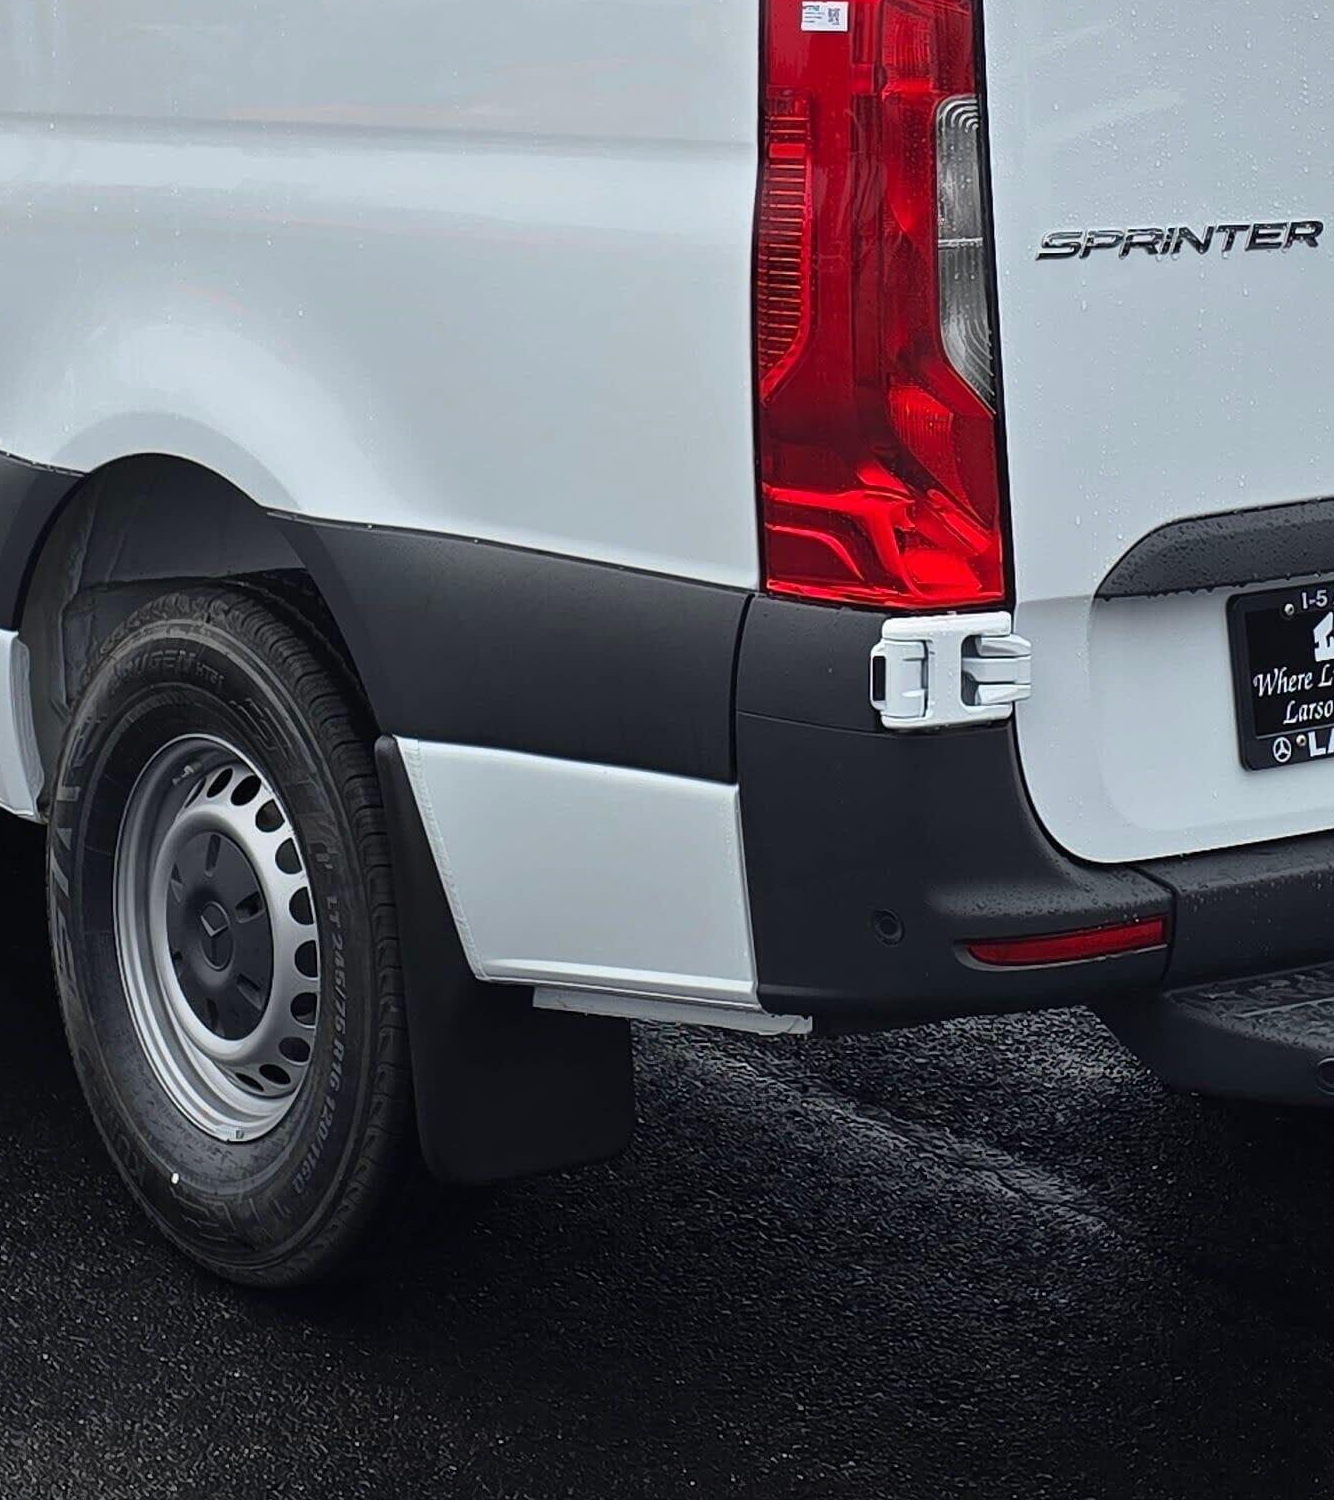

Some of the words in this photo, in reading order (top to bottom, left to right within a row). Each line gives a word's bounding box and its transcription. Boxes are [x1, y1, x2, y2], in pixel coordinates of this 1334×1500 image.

[1035, 220, 1324, 261] SPRINTER
[1302, 589, 1327, 609] I-5
[1253, 667, 1312, 697] Where
